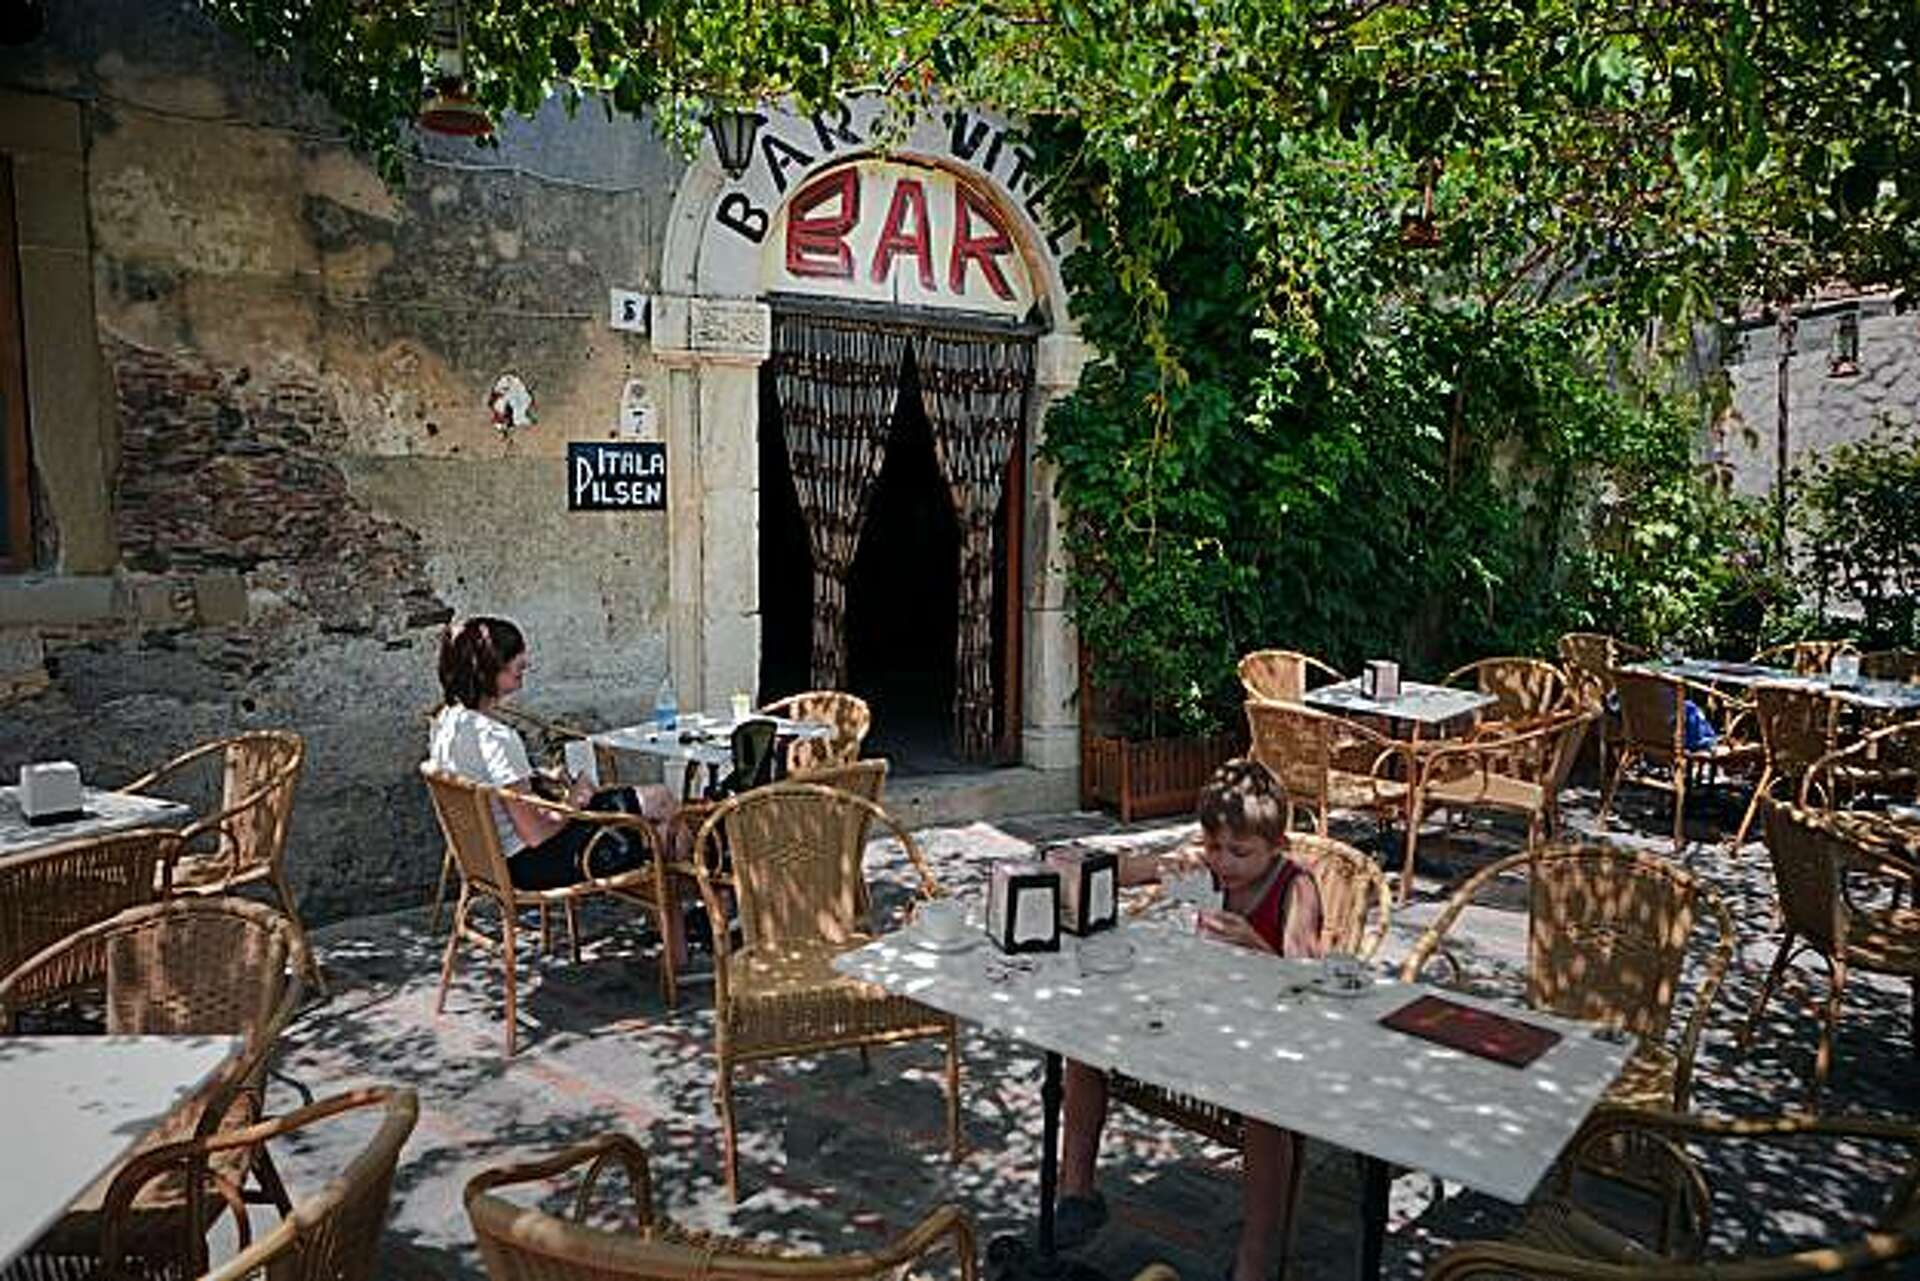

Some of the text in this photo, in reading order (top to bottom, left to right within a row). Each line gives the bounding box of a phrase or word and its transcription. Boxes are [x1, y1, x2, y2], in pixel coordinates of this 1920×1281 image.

[716, 99, 865, 243] BAR
[786, 165, 1017, 301] BAR
[576, 456, 663, 505] PILSEN
[598, 447, 665, 475] ITALA
